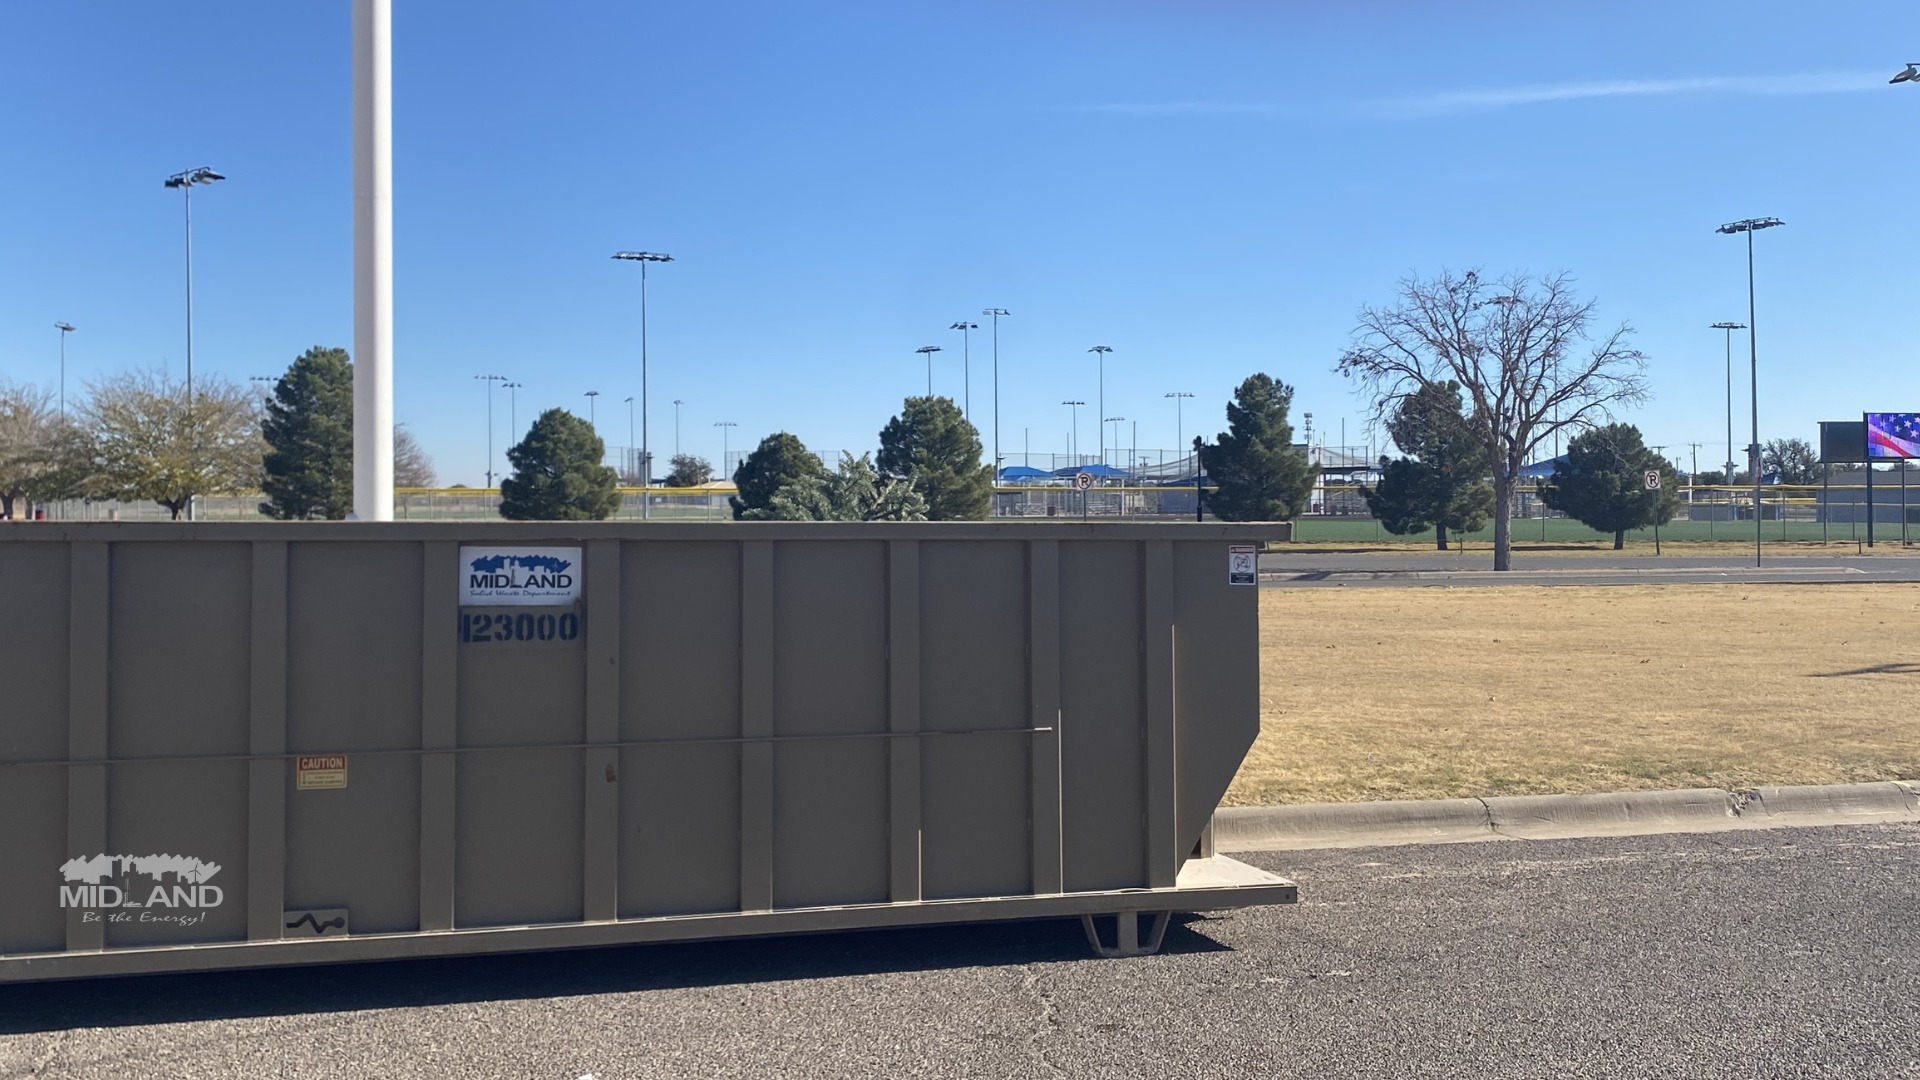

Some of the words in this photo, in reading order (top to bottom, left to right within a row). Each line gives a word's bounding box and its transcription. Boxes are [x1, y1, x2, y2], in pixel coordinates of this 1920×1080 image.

[470, 573, 573, 589] MIDLAND
[523, 590, 571, 598] Department
[463, 613, 579, 643] 123000
[302, 757, 343, 770] CAUTION
